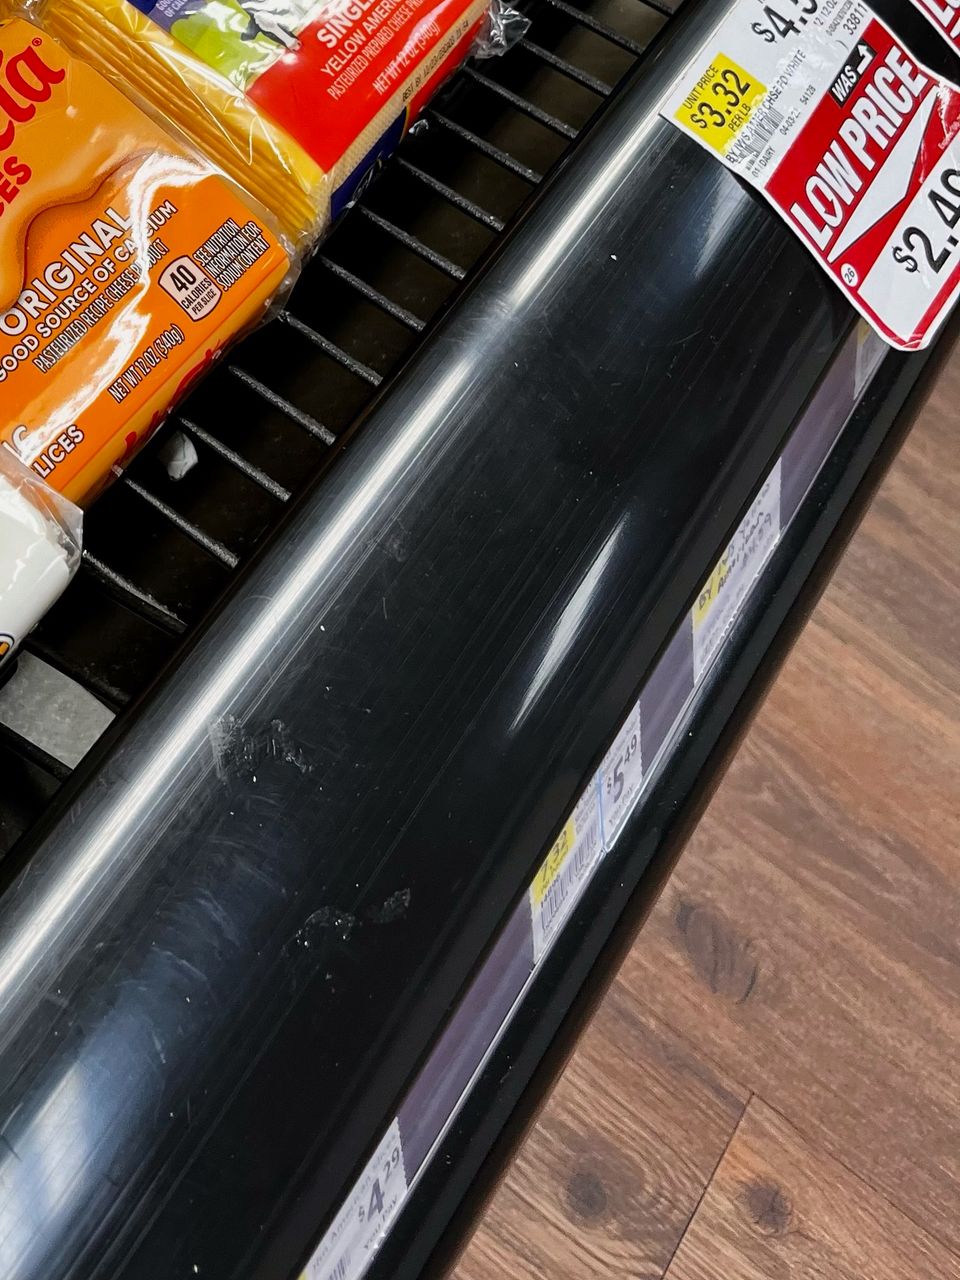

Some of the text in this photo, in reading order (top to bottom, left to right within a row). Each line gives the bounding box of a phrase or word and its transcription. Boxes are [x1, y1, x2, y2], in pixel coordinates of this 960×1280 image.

[843, 3, 869, 36] 33811
[320, 24, 370, 79] YELLOW
[683, 64, 720, 110] UNIT PRICE
[690, 69, 752, 130] $3.32
[832, 64, 857, 102] WAS
[728, 103, 752, 132] PER LB
[790, 44, 929, 252] LOW PRICE
[181, 276, 213, 310] CALORIES
[844, 267, 856, 285] 26
[107, 322, 186, 404] NET WT 12 OZ (340g)
